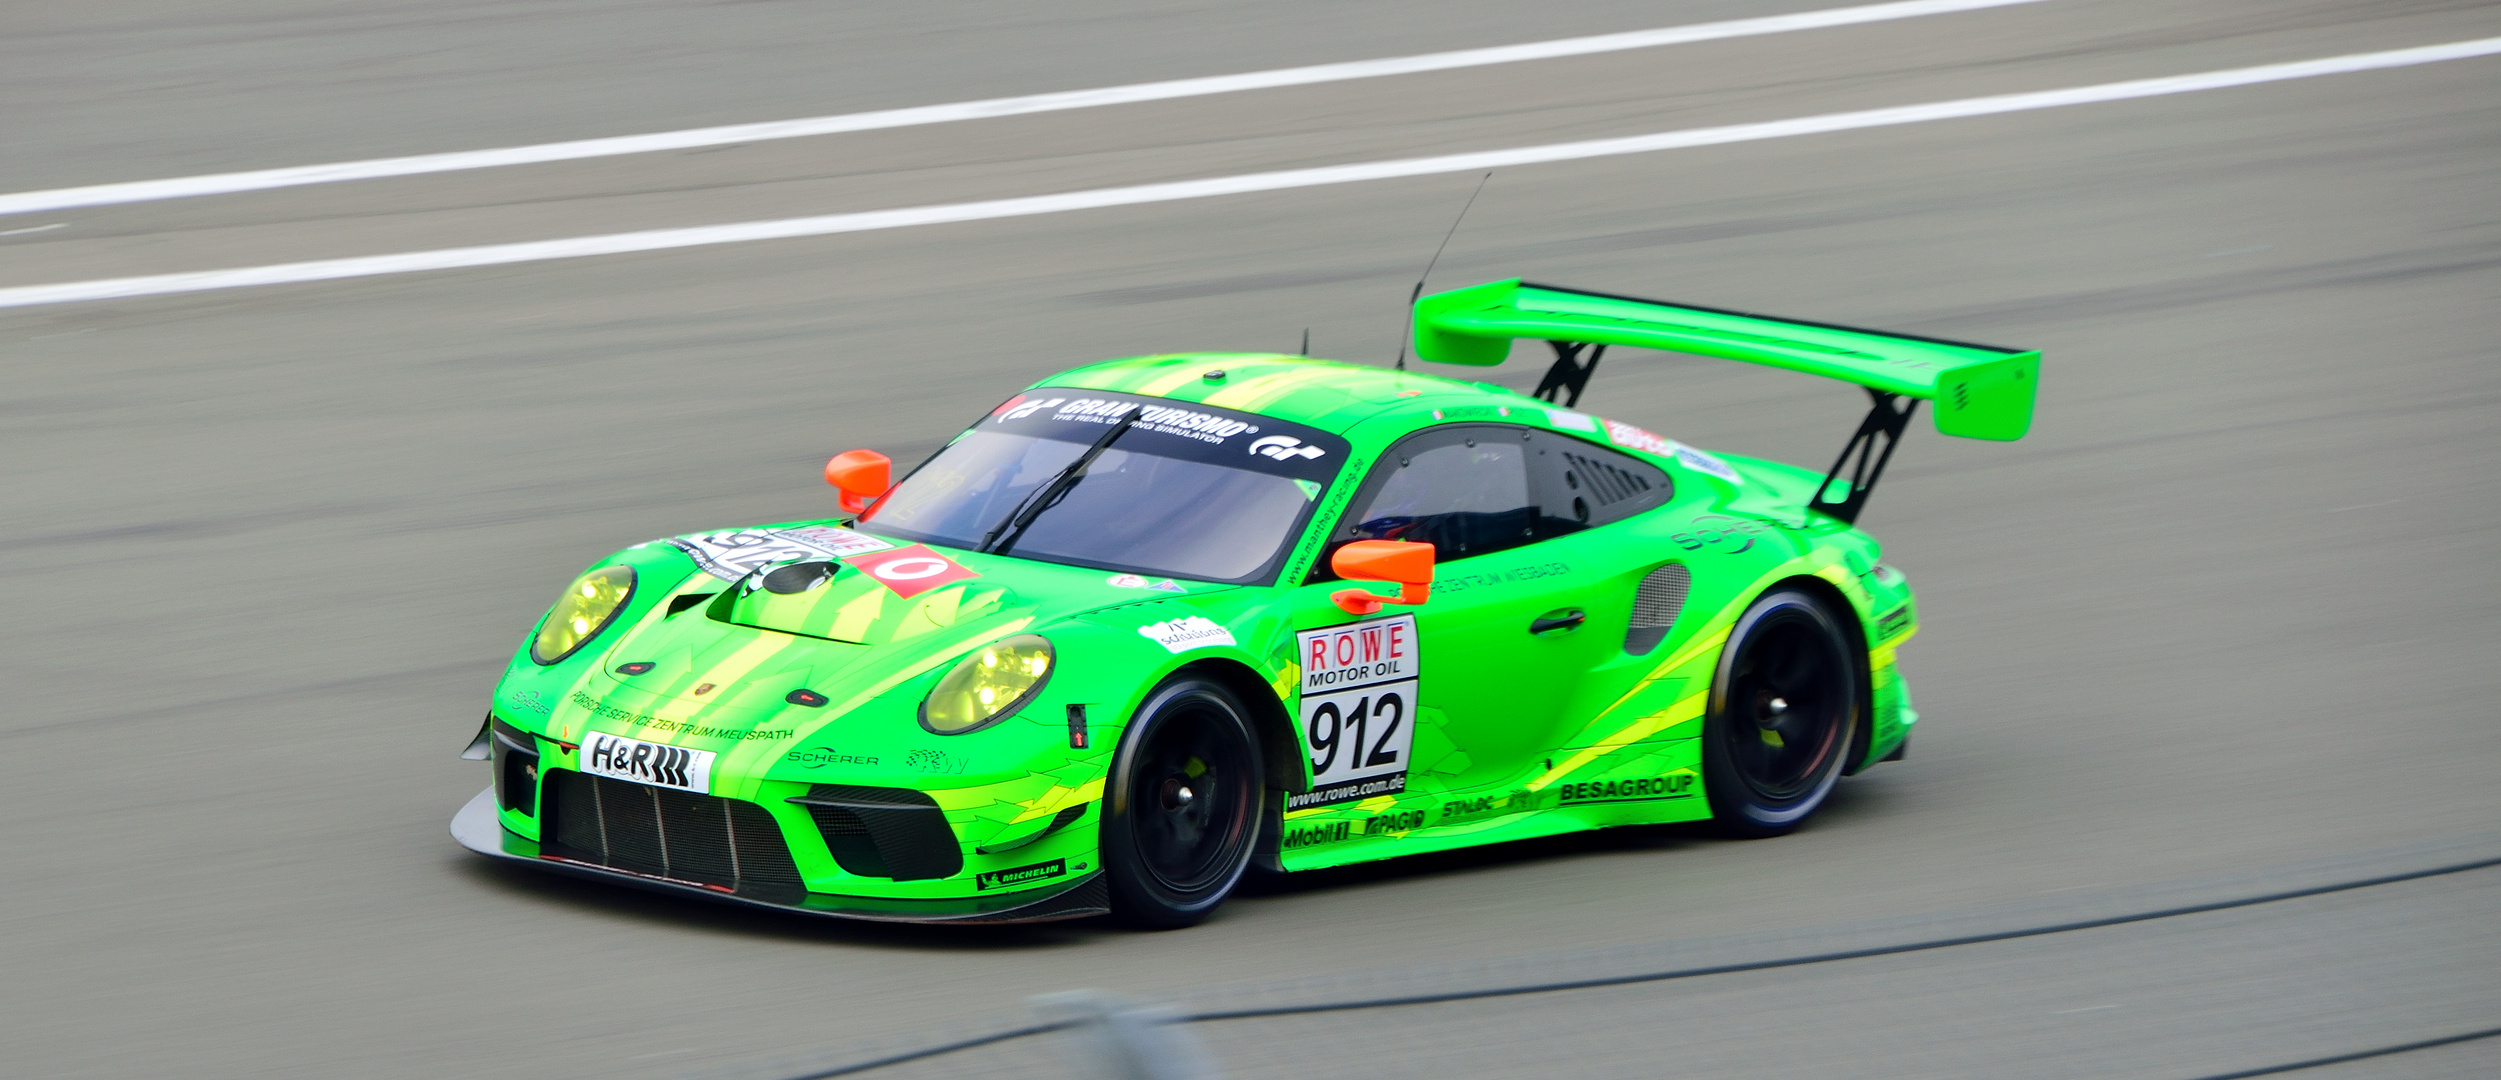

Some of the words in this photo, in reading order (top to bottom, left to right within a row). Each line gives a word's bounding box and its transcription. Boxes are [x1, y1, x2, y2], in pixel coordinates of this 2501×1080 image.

[1059, 398, 1139, 417] GRAN
[1052, 413, 1073, 421] THE
[1075, 414, 1105, 423] REAL
[1154, 424, 1225, 445] SIMULATOR
[1287, 458, 1365, 584] www.manthey-racing.de
[1308, 623, 1404, 672] ROWE
[1308, 666, 1369, 688] MOTOR
[1375, 660, 1401, 677] OIL
[571, 690, 609, 715] PORSCHE
[606, 706, 653, 728] SERVICE
[652, 719, 716, 738] ZENTRUM
[716, 729, 793, 741] MEUSPATH
[1309, 692, 1404, 776] 912
[592, 734, 652, 779] H&R
[787, 748, 879, 767] SCHERER
[1288, 777, 1405, 808] www.rowe.com.de
[1560, 775, 1694, 801] BESAGROUP
[1289, 824, 1334, 848] Mobil
[1002, 865, 1059, 882] MICHELIN
